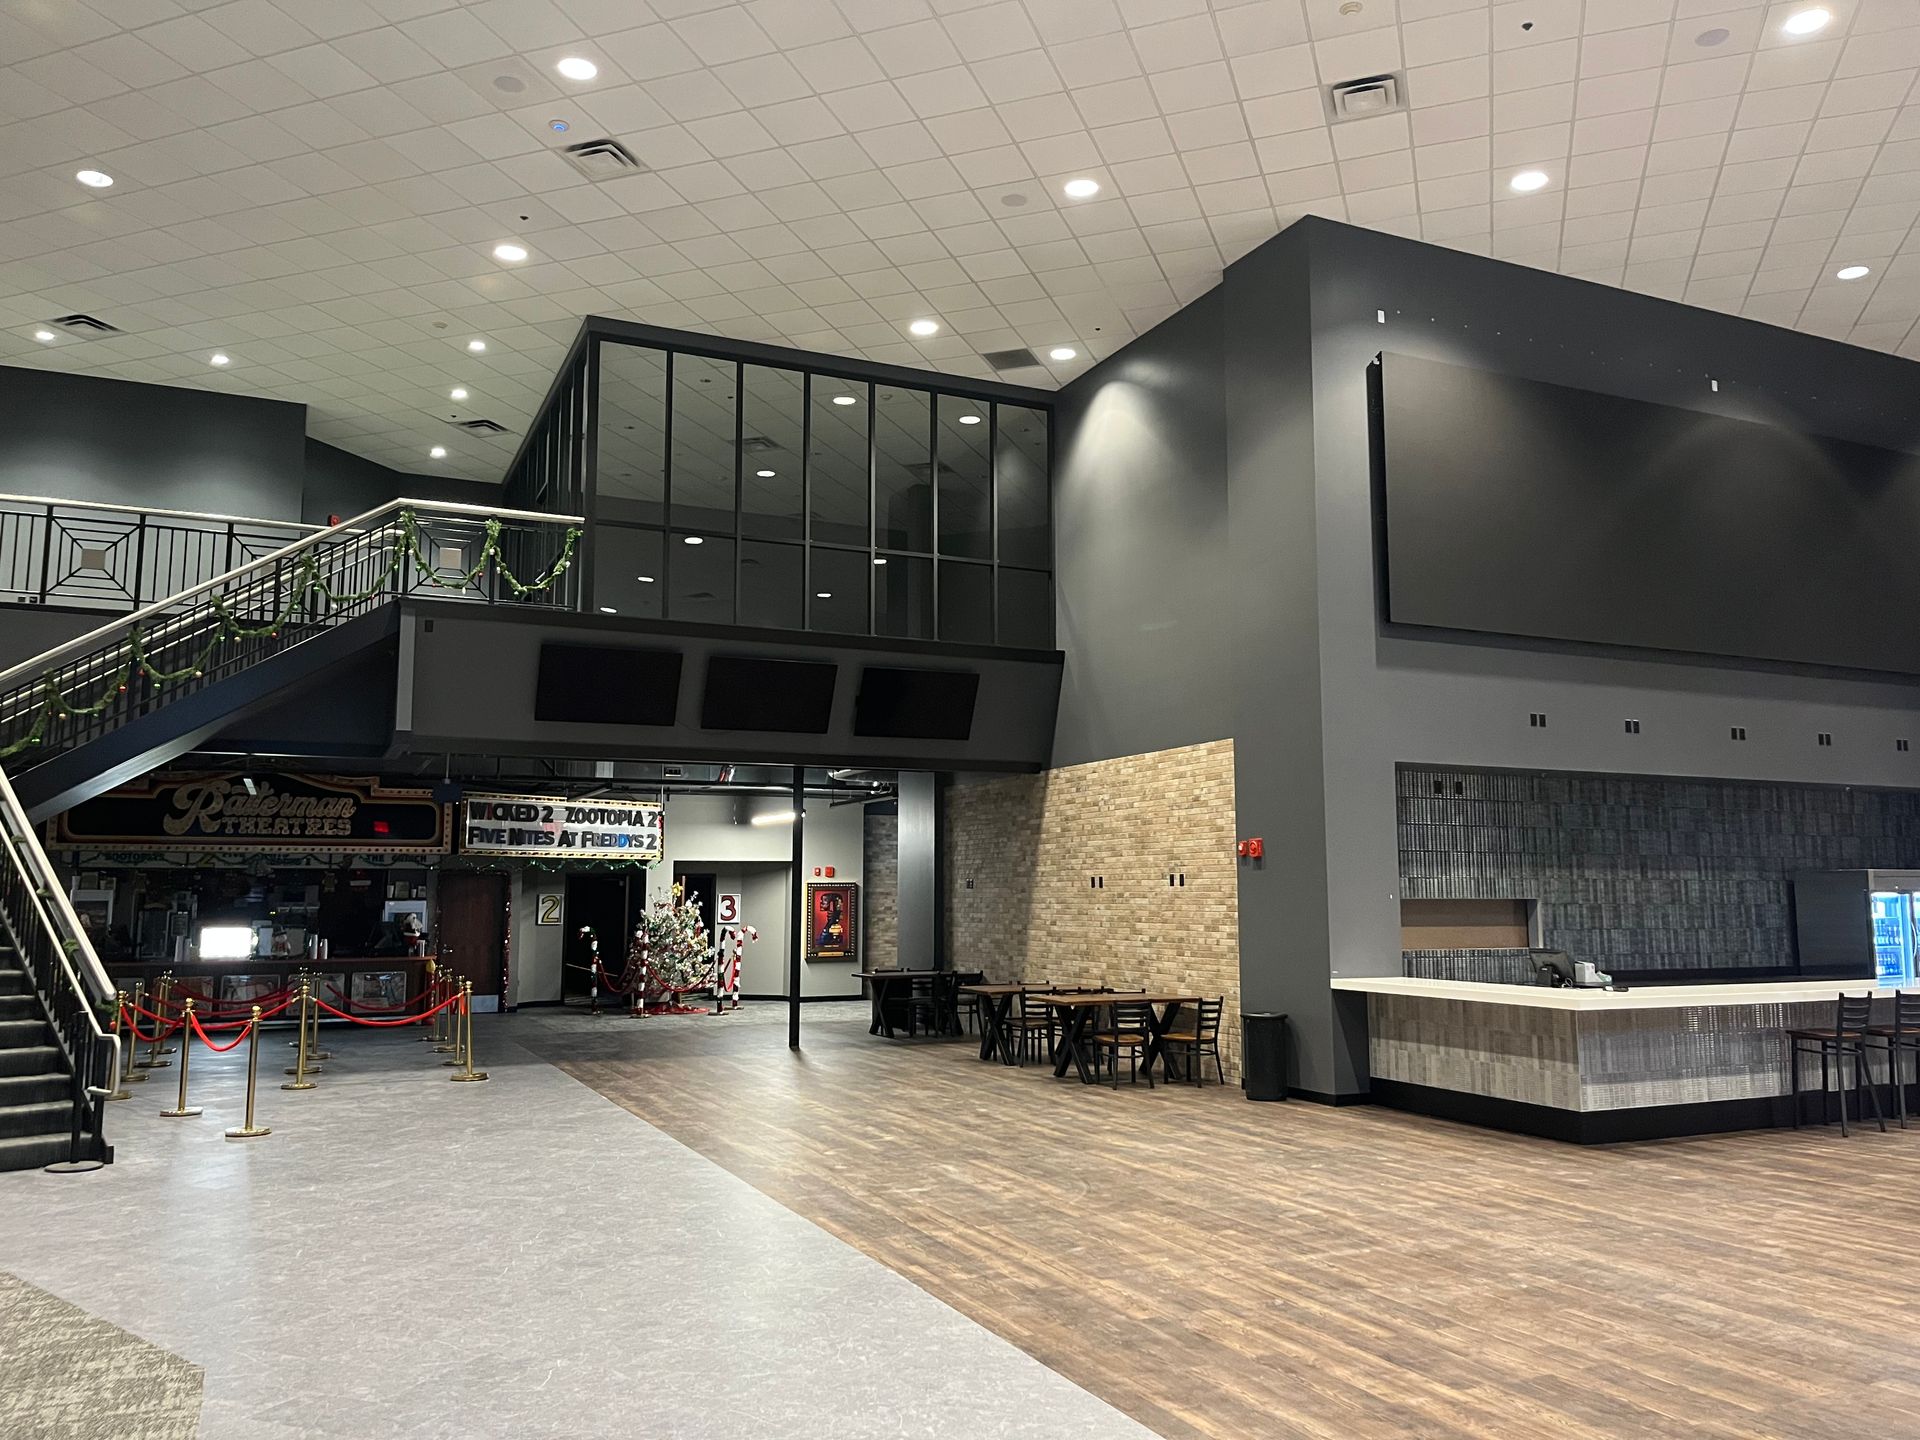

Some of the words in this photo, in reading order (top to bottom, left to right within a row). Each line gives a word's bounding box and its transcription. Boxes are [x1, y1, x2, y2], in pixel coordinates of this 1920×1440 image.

[221, 816, 351, 835] THEATRES
[469, 801, 539, 822] WICKED
[541, 805, 554, 823] 2
[565, 806, 644, 827] ZOOTOPIA
[647, 811, 658, 828] 2
[468, 826, 506, 845] FIVE
[507, 828, 555, 846] NITES
[557, 830, 578, 848] AT
[581, 831, 644, 848] FREDDYS
[646, 833, 657, 850] 2
[541, 895, 561, 923] 2
[721, 895, 737, 921] 3
